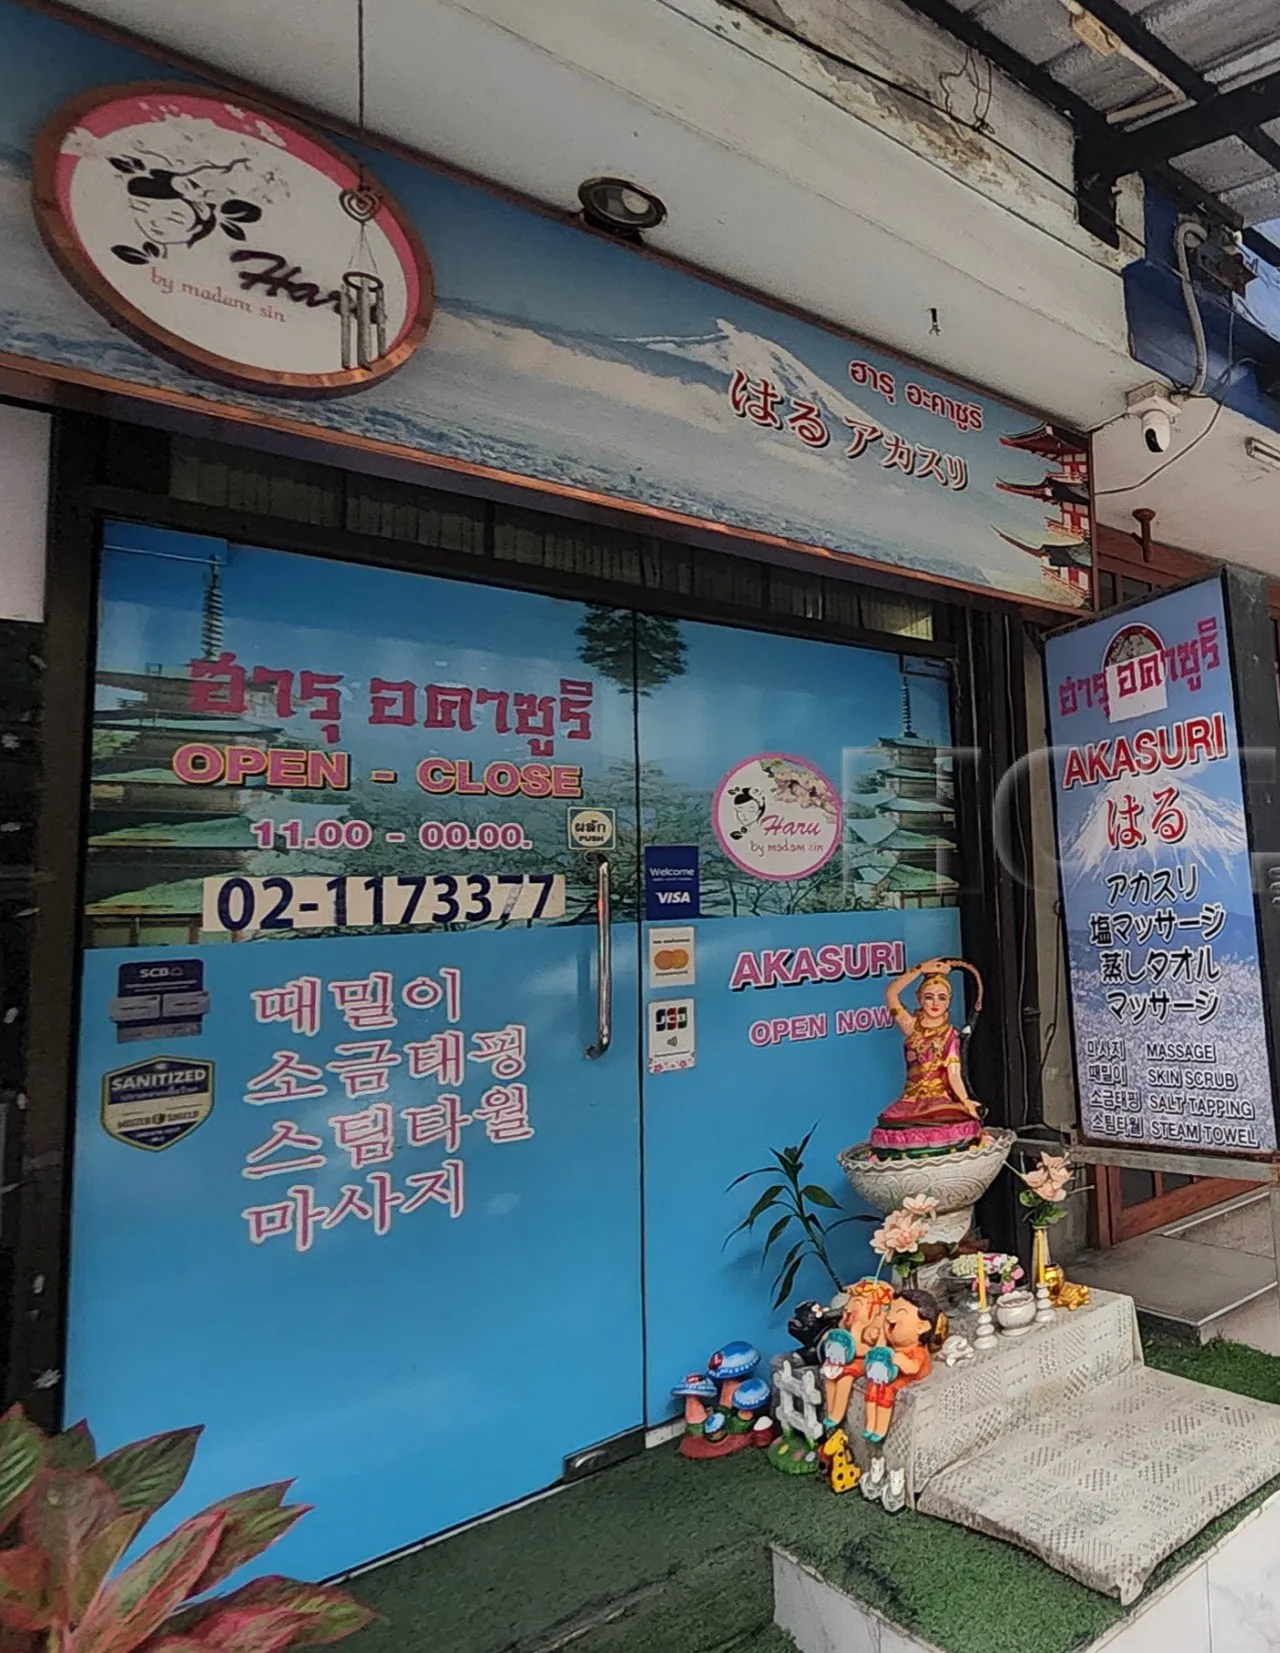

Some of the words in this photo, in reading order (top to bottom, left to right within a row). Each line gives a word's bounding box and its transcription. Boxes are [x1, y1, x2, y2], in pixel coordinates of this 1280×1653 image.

[150, 266, 174, 294] by
[181, 280, 253, 314] madam
[258, 305, 287, 324] sin
[730, 368, 832, 448] はる
[843, 415, 970, 492] アカスリ
[1063, 711, 1227, 790] AKASURI
[172, 743, 349, 789] OPEN
[416, 757, 582, 798] CLOSE
[574, 819, 607, 833] ผลัก
[761, 814, 822, 836] Haru
[1106, 786, 1186, 848] はる
[251, 819, 372, 850] 11.00
[418, 821, 532, 851] 00.00.
[579, 834, 605, 842] PUSH
[750, 839, 765, 858] by
[767, 837, 806, 852] madam
[648, 867, 695, 877] Welcome
[1105, 864, 1199, 907] アカスリ
[217, 874, 554, 931] 02-1173377
[655, 891, 692, 904] VISA
[1089, 902, 1227, 948] 塩マッサージ
[139, 967, 171, 978] SCB
[729, 941, 904, 991] AKASURI
[1100, 945, 1222, 985] 蒸しタオル
[252, 967, 461, 1036] 때밀이
[1106, 987, 1221, 1026] マッサージ
[655, 1006, 688, 1032] JCB
[749, 1012, 828, 1047] OPEN
[836, 1005, 895, 1035] NOW
[1086, 1040, 1126, 1061] 마사지
[1146, 1042, 1216, 1063] MASSAGE
[111, 1068, 207, 1092] SANITIZED
[1087, 1063, 1128, 1086] 때밀이
[1147, 1067, 1182, 1087] SKIN
[1185, 1070, 1238, 1091] SCRUB
[1089, 1088, 1143, 1112] 소금태핑
[1149, 1093, 1185, 1115] SALT
[1187, 1097, 1255, 1120] TAPPING
[242, 1084, 535, 1179] 스팀타월
[1091, 1113, 1144, 1138] 스팀타월
[1151, 1119, 1200, 1143] STEAM
[1202, 1124, 1260, 1148] TOWEL
[242, 1160, 464, 1252] 마사지
